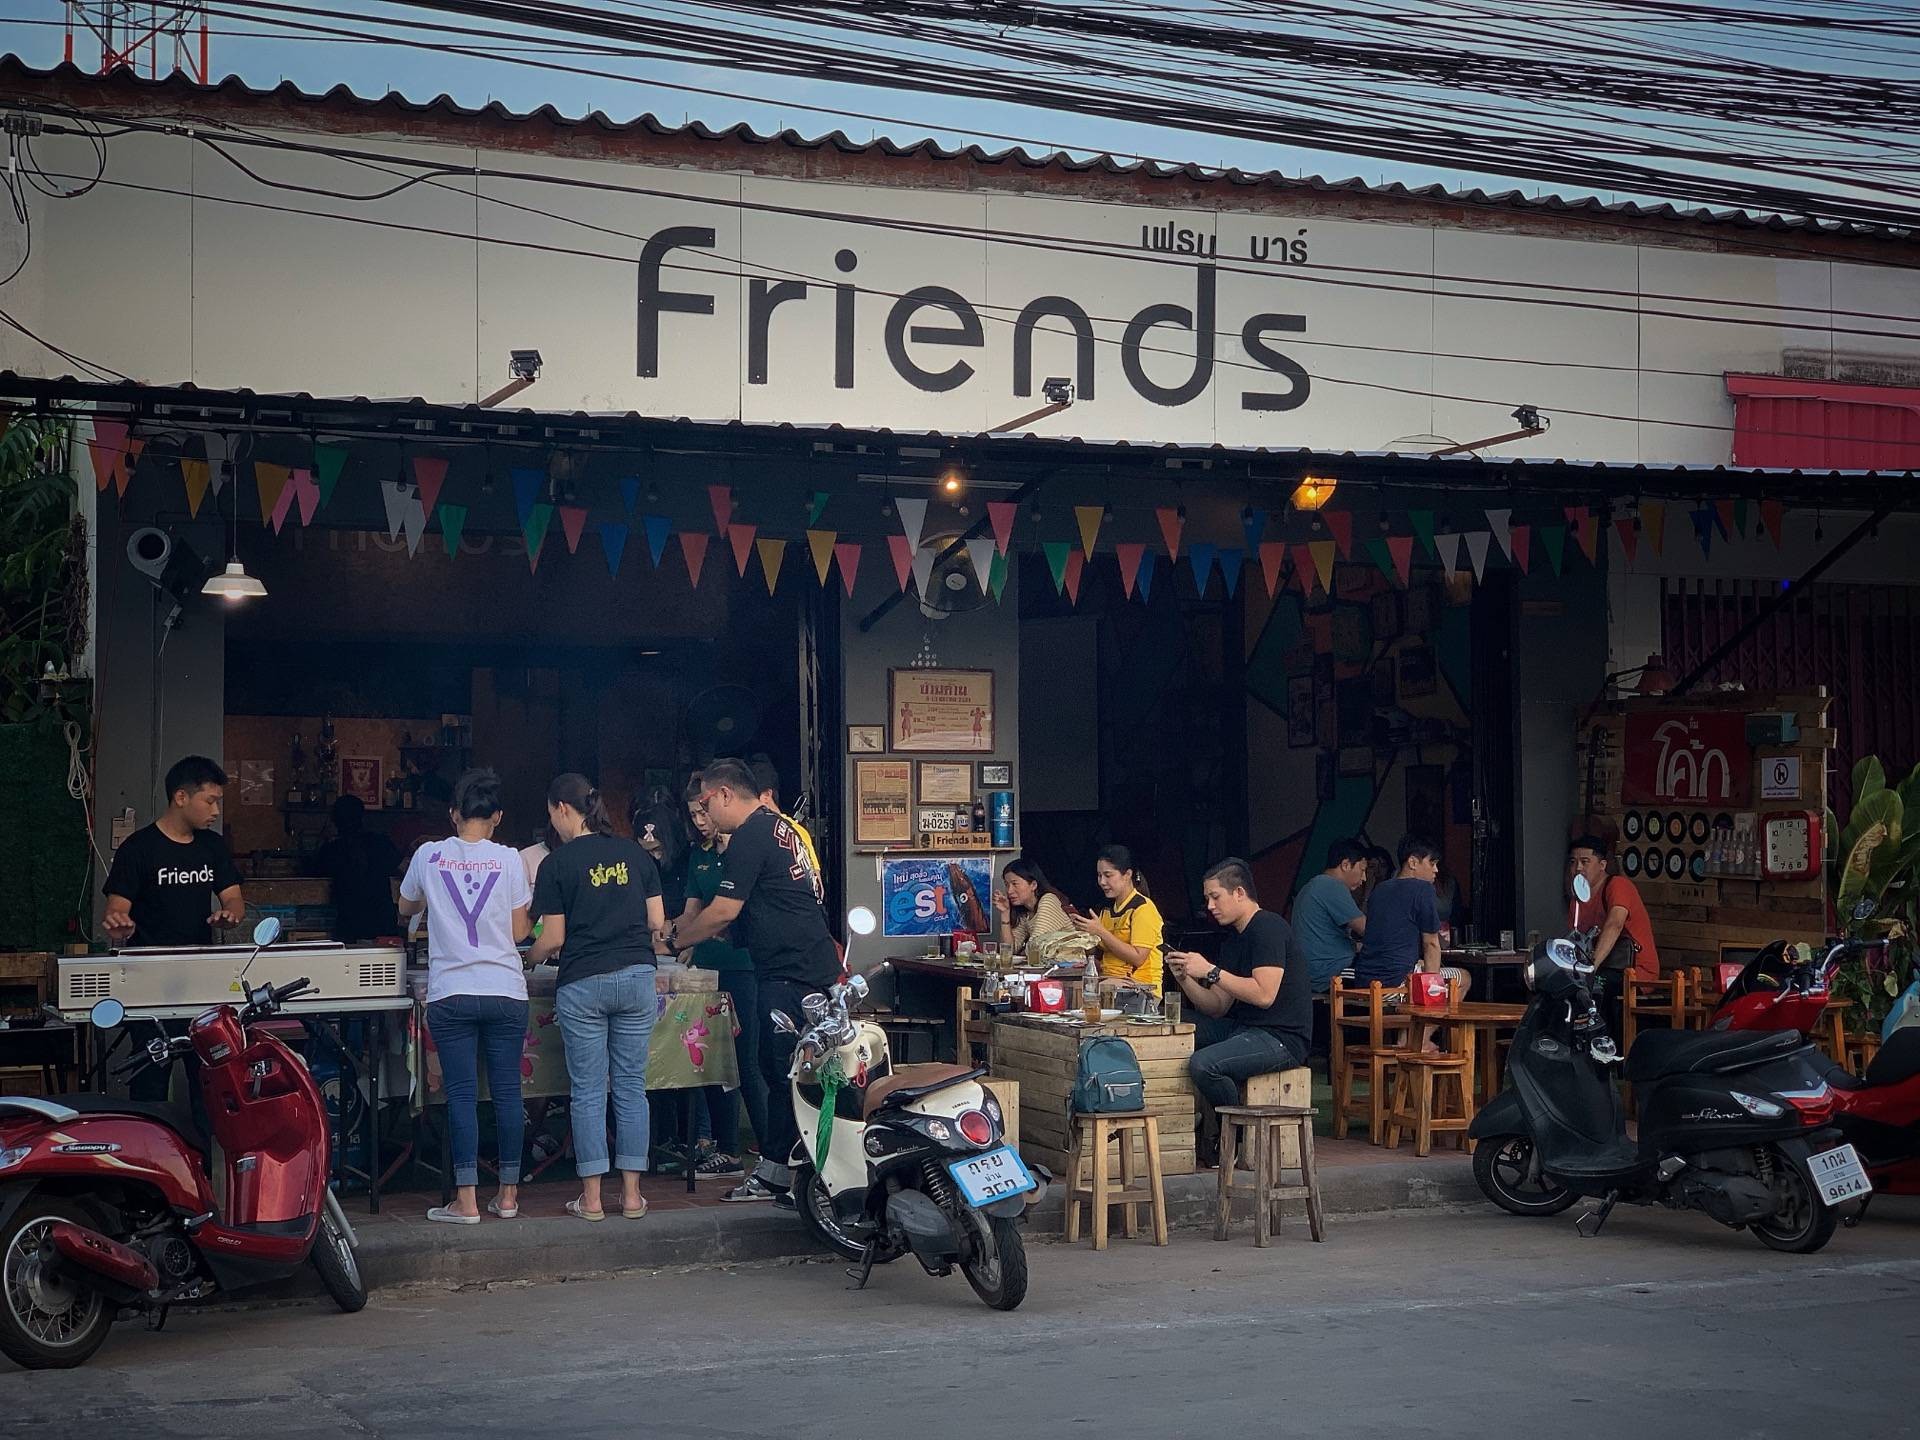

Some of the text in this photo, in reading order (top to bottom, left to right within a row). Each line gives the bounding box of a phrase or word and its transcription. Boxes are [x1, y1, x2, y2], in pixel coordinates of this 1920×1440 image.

[1250, 228, 1308, 265] บาร์
[1652, 719, 1731, 798] โค้ก
[937, 835, 970, 845] Friends
[890, 884, 947, 923] est
[933, 914, 949, 922] COLA
[985, 1172, 1002, 1182] น่าน
[1829, 1179, 1862, 1199] 9614
